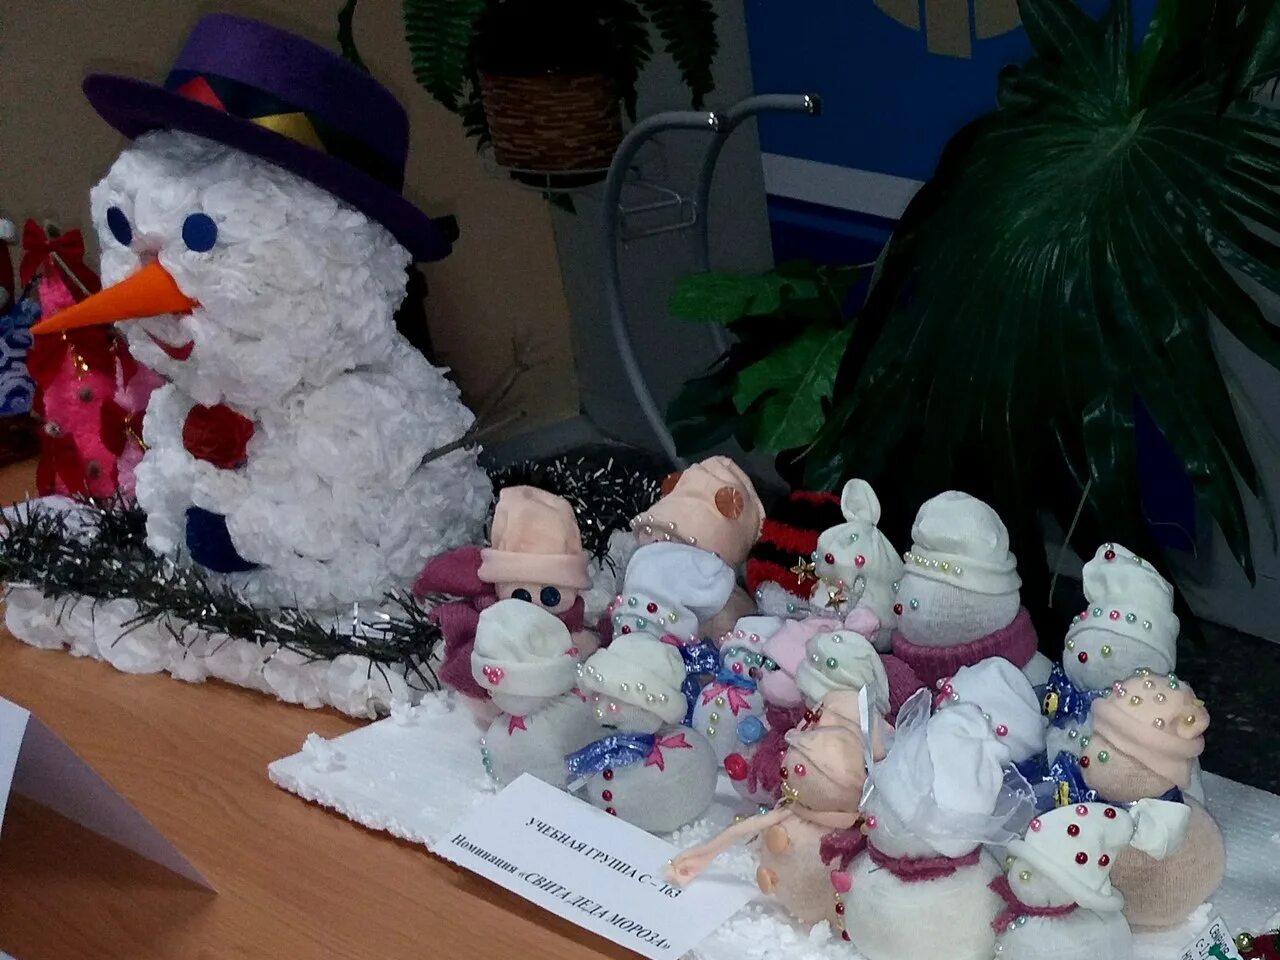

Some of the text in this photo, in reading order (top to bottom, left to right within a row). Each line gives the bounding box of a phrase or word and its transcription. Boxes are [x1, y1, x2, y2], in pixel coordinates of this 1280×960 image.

[450, 833, 671, 951] Номинация «СВИТА ДЕДА МОРОЗА»
[525, 816, 589, 854] УЧЕБНАЯ
[588, 846, 638, 884] ГРУППА
[657, 883, 682, 899] 163
